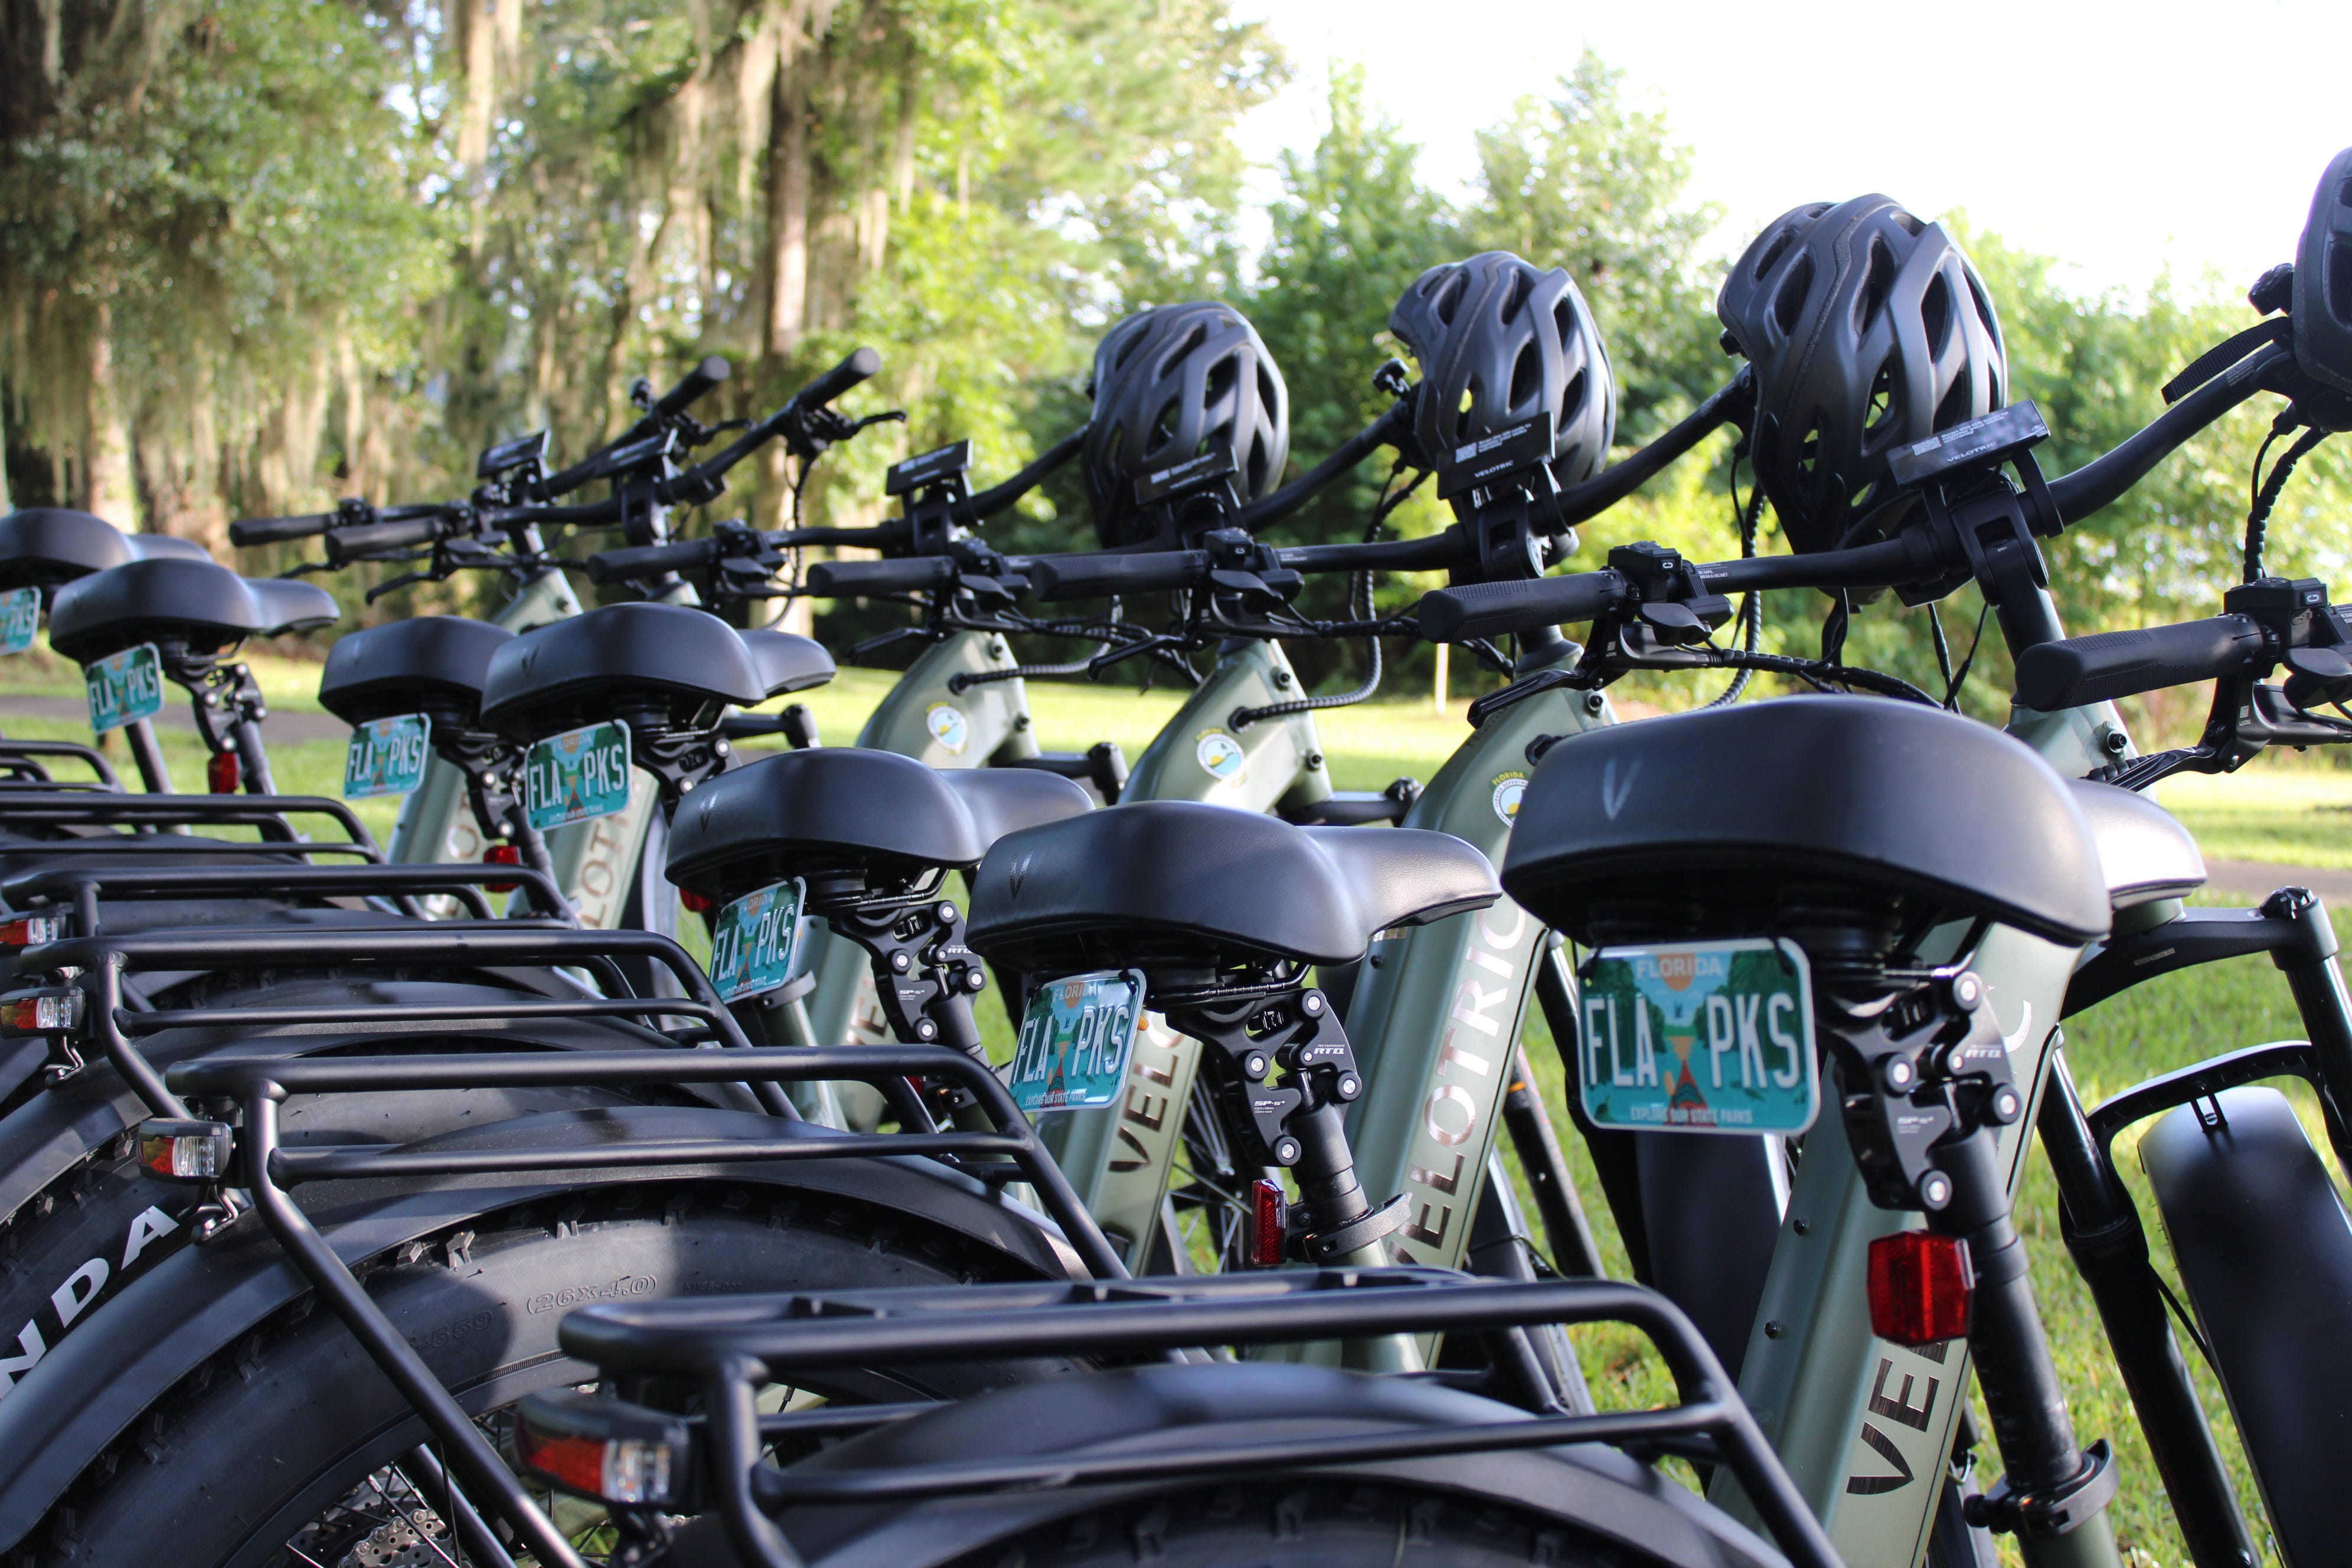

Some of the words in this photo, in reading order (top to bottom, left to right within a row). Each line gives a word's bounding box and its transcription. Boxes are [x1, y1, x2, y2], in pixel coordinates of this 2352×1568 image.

[1947, 441, 1998, 462] VELOTRIC
[1475, 460, 1514, 478] VELOTRIC
[89, 678, 116, 719] FLA
[126, 662, 157, 705] PKS
[346, 740, 373, 783] FLA
[387, 734, 423, 777] PKS
[530, 759, 561, 812] FLA
[583, 744, 626, 798] PKS
[1492, 770, 1525, 786] FLORIDA
[710, 924, 740, 984] FLA
[754, 904, 795, 968] PKS
[1636, 956, 1723, 980] FLORIDA
[1052, 982, 1099, 1003] FLORIDA
[1012, 1013, 1055, 1084] FLA
[1070, 1004, 1129, 1077] PKS
[1585, 993, 1658, 1087] FLA
[1706, 992, 1801, 1089] PKS
[1025, 1093, 1044, 1106] EXPLORE
[1054, 1093, 1069, 1104] STATE
[1069, 1092, 1086, 1102] PARKS
[1630, 1106, 1668, 1121] EXPLORE
[1670, 1108, 1688, 1123] OUR
[1691, 1108, 1718, 1123] STATE
[1720, 1108, 1753, 1124] PARKS
